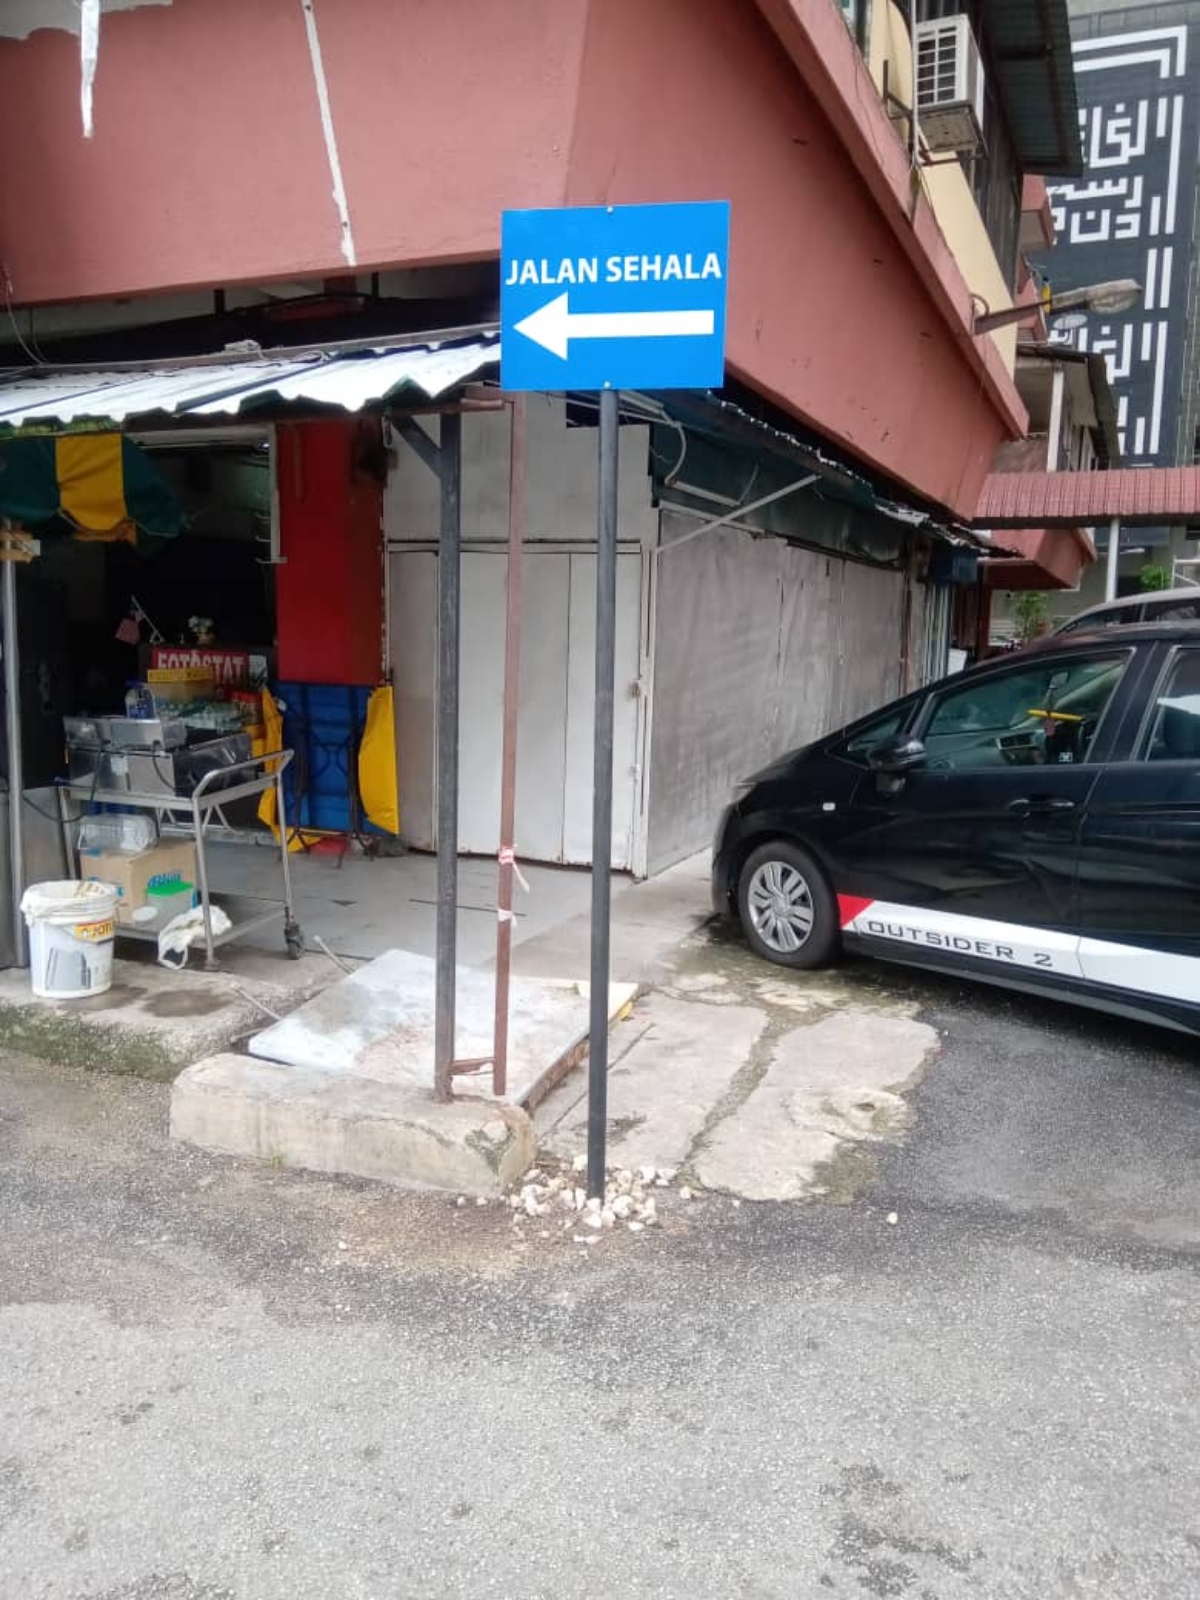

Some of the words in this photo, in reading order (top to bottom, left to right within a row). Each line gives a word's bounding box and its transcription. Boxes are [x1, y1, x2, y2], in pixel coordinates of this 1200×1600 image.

[505, 257, 598, 286] JALAN
[605, 252, 722, 283] SEHALA
[868, 920, 1014, 960] OUTSIDER
[1033, 953, 1053, 968] 2
